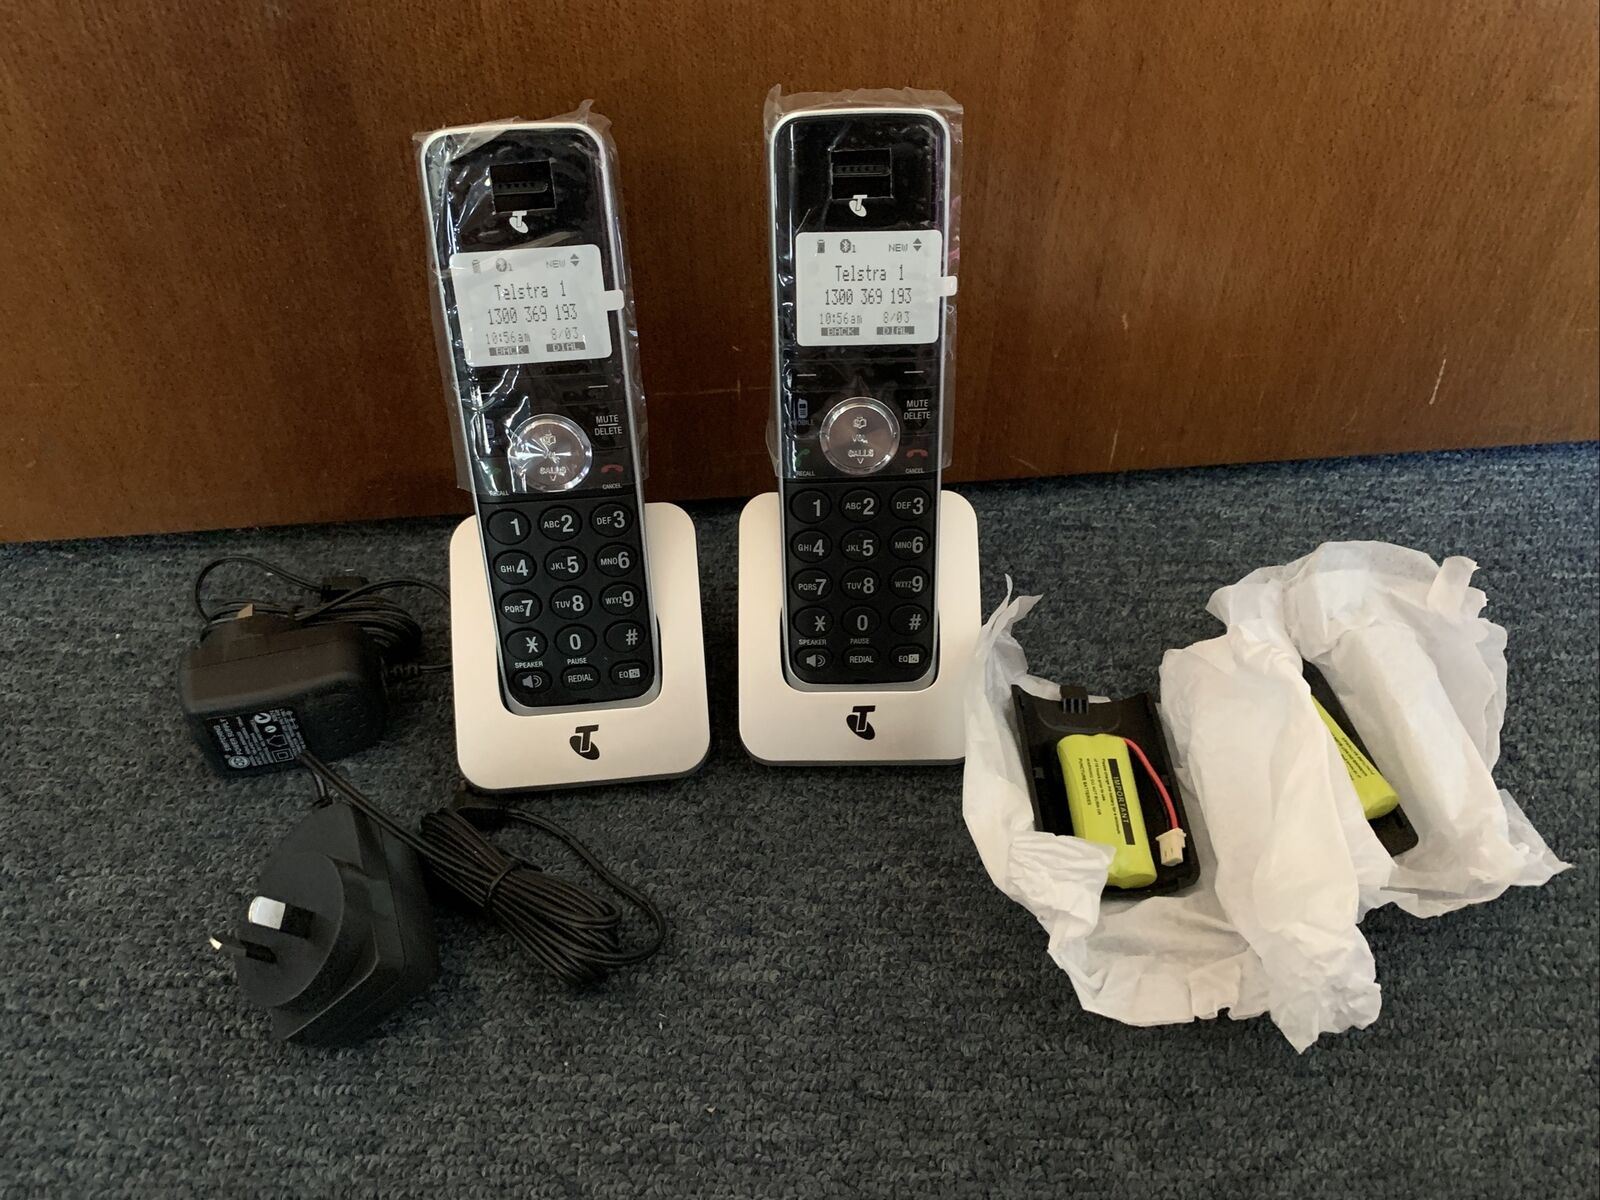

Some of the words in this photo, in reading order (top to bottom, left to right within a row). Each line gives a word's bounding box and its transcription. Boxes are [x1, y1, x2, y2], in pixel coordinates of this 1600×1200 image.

[888, 244, 908, 252] NEW
[835, 265, 887, 282] Telstra
[899, 264, 904, 281] 1
[494, 282, 548, 300] Telstra
[560, 280, 566, 297] 1
[825, 289, 853, 305] 1300
[861, 288, 883, 304] 369
[891, 288, 912, 304] 193
[487, 307, 518, 325] 1300
[524, 305, 548, 322] 369
[555, 303, 578, 321] 193
[820, 312, 863, 325] 10:56am
[883, 311, 910, 324] 8/03
[485, 331, 531, 345] 10:56am
[551, 327, 580, 341] 8/03
[906, 399, 929, 408] MUTE
[595, 414, 620, 424] MUTE
[904, 411, 931, 420] DELETE
[594, 426, 623, 436] DELETE
[812, 499, 821, 516] 1
[846, 502, 862, 510] ABC
[863, 498, 874, 515] 2
[896, 502, 912, 510] DEF
[912, 497, 924, 514] 3
[510, 518, 521, 536] 1
[544, 520, 560, 529] ABC
[561, 514, 574, 532] 2
[596, 516, 612, 526] DEF
[613, 510, 626, 528] 3
[798, 543, 812, 552] GHI
[813, 539, 825, 556] 4
[846, 544, 861, 552] JKL
[862, 540, 874, 556] 5
[895, 541, 912, 549] MNO
[912, 536, 924, 554] 6
[500, 564, 515, 573] GHI
[516, 559, 528, 576] 4
[550, 562, 566, 571] JKL
[567, 556, 579, 573] 5
[600, 557, 618, 566] MNO
[618, 552, 630, 569] 6
[798, 582, 817, 591] PQRS
[816, 578, 826, 596] 7
[846, 582, 862, 590] TUV
[863, 578, 874, 594] 8
[912, 576, 924, 592] 9
[555, 600, 571, 608] TUV
[572, 594, 584, 612] 8
[605, 596, 622, 604] WXYZ
[622, 590, 634, 608] 9
[504, 605, 524, 613] PQRS
[522, 600, 533, 616] 7
[856, 614, 868, 632] 0
[908, 614, 922, 630] #
[569, 634, 582, 650] 0
[626, 628, 638, 646] #
[514, 660, 544, 670] SPEAKER
[567, 658, 588, 666] PAUSE
[850, 656, 874, 664] REDIAL
[568, 673, 594, 684] REDIAL
[1114, 777, 1129, 822] IMPORTANT
